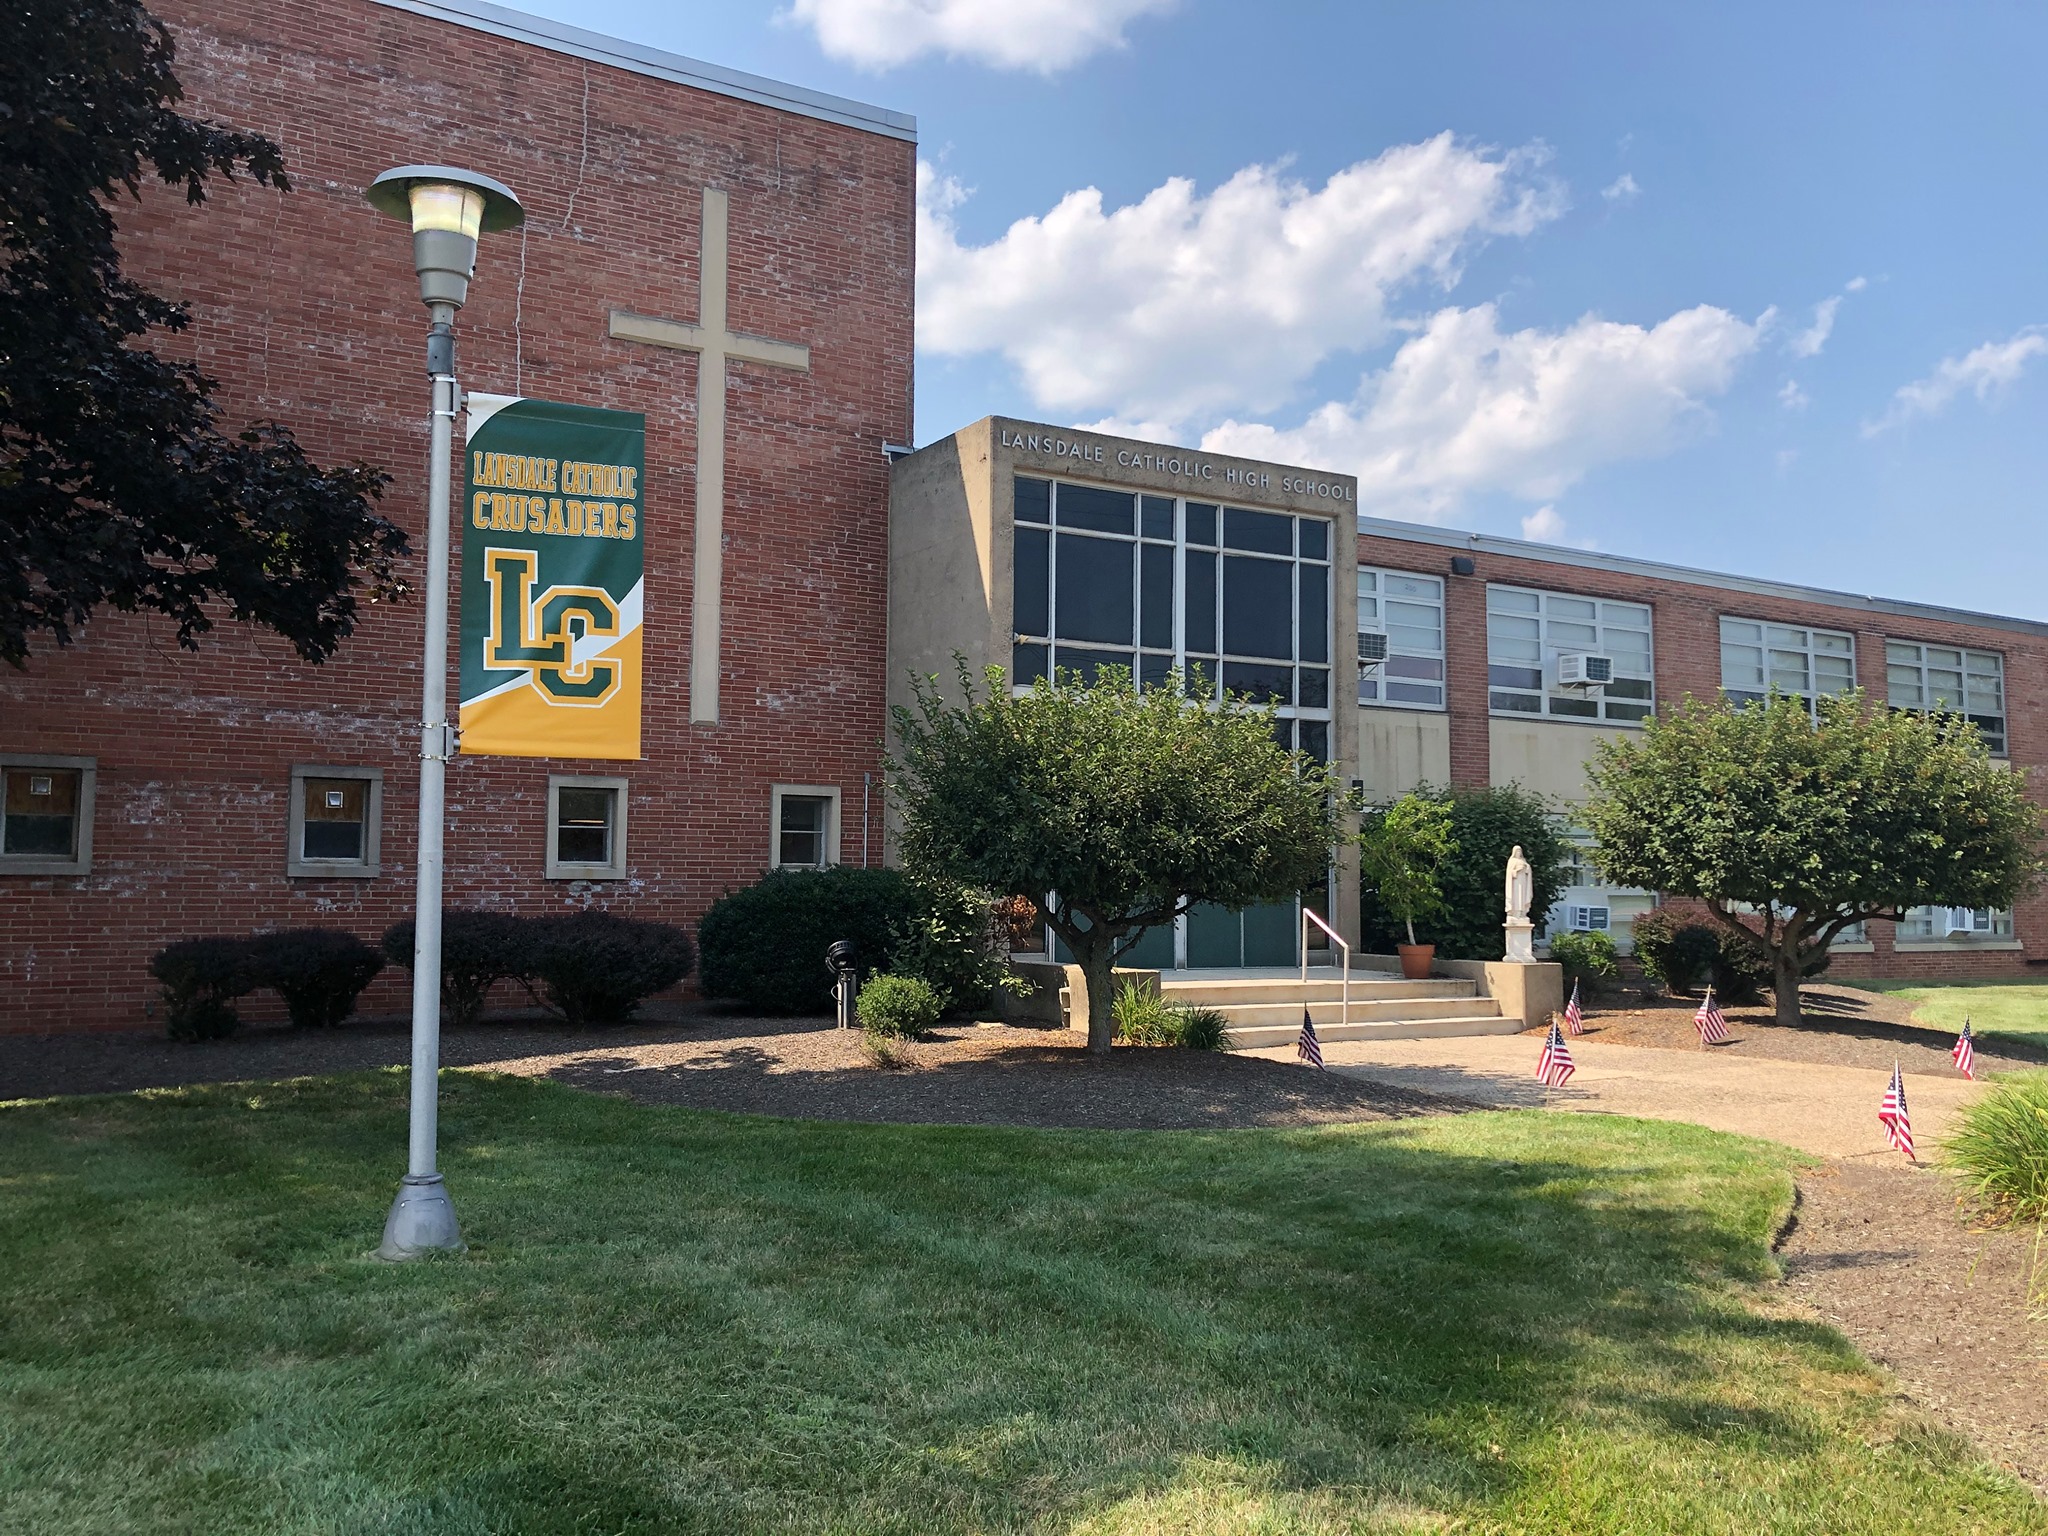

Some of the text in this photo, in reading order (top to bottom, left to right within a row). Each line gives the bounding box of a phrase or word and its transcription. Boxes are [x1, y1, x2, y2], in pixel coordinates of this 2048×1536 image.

[473, 451, 637, 499] LANSDALE CATHOLIC
[1002, 430, 1353, 501] LANSDALE CATHOLIC HIGH SCHOOL
[472, 491, 637, 540] CRUSADERS
[483, 546, 622, 708] LC
